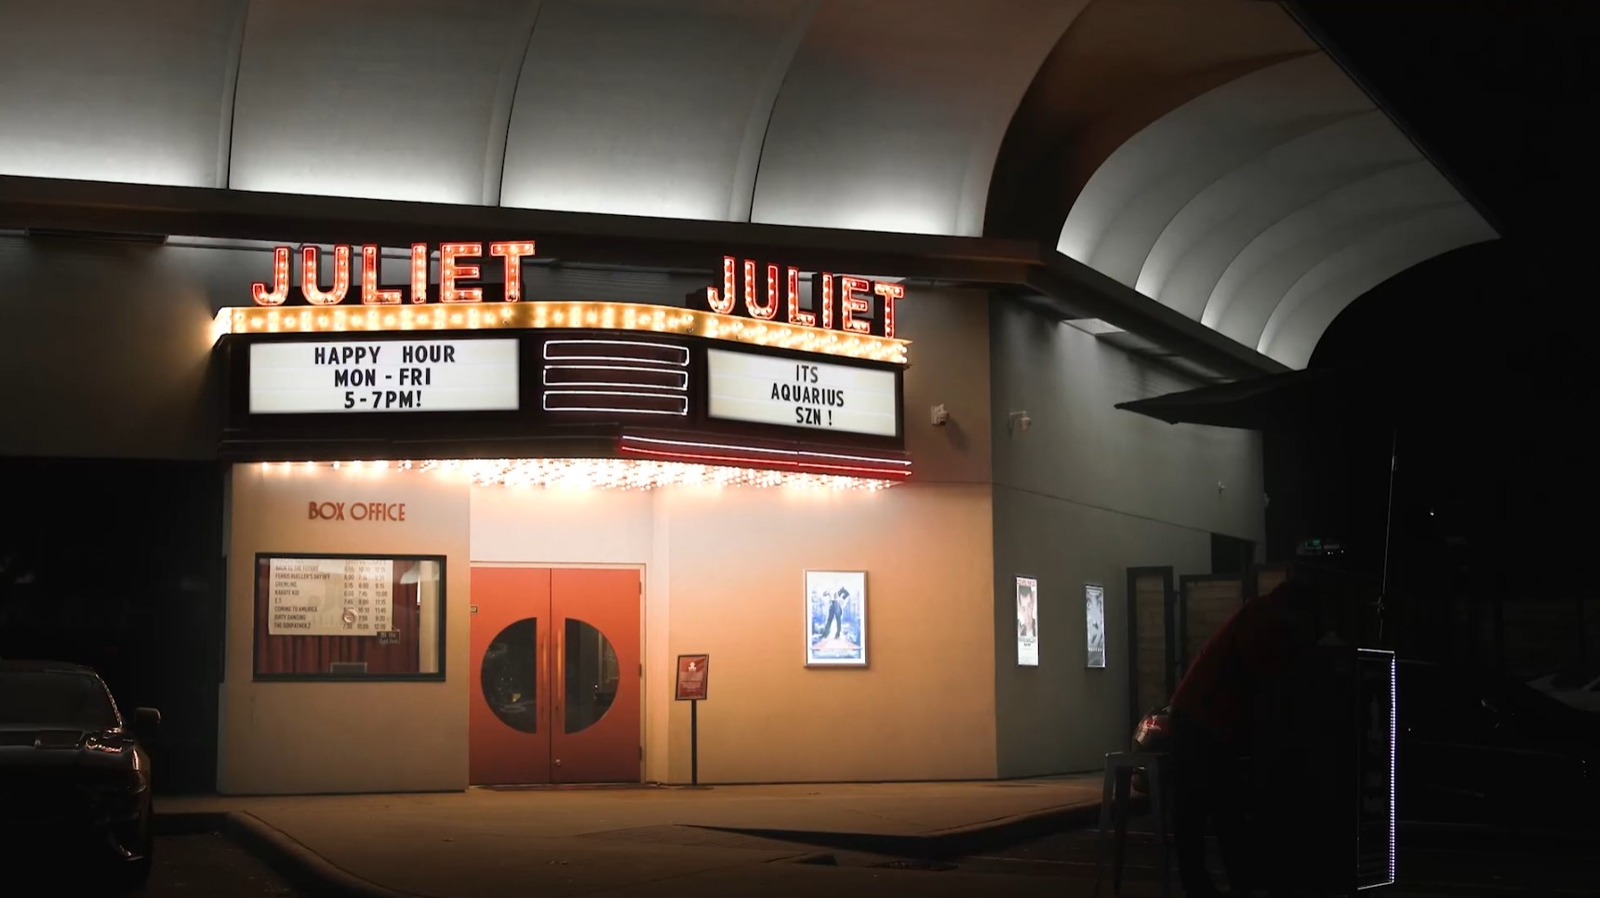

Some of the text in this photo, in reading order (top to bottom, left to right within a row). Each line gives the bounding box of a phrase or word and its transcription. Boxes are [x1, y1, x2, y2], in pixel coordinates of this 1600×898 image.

[252, 240, 535, 305] JULIET
[707, 255, 905, 339] JULIET
[314, 345, 456, 365] HAPPY HOUR
[334, 369, 376, 387] MON
[399, 367, 431, 386] FRI
[795, 364, 819, 384] ITS
[770, 382, 845, 408] AQUARIUS
[795, 407, 822, 426] SZN
[308, 501, 406, 522] BOX OFFICE
